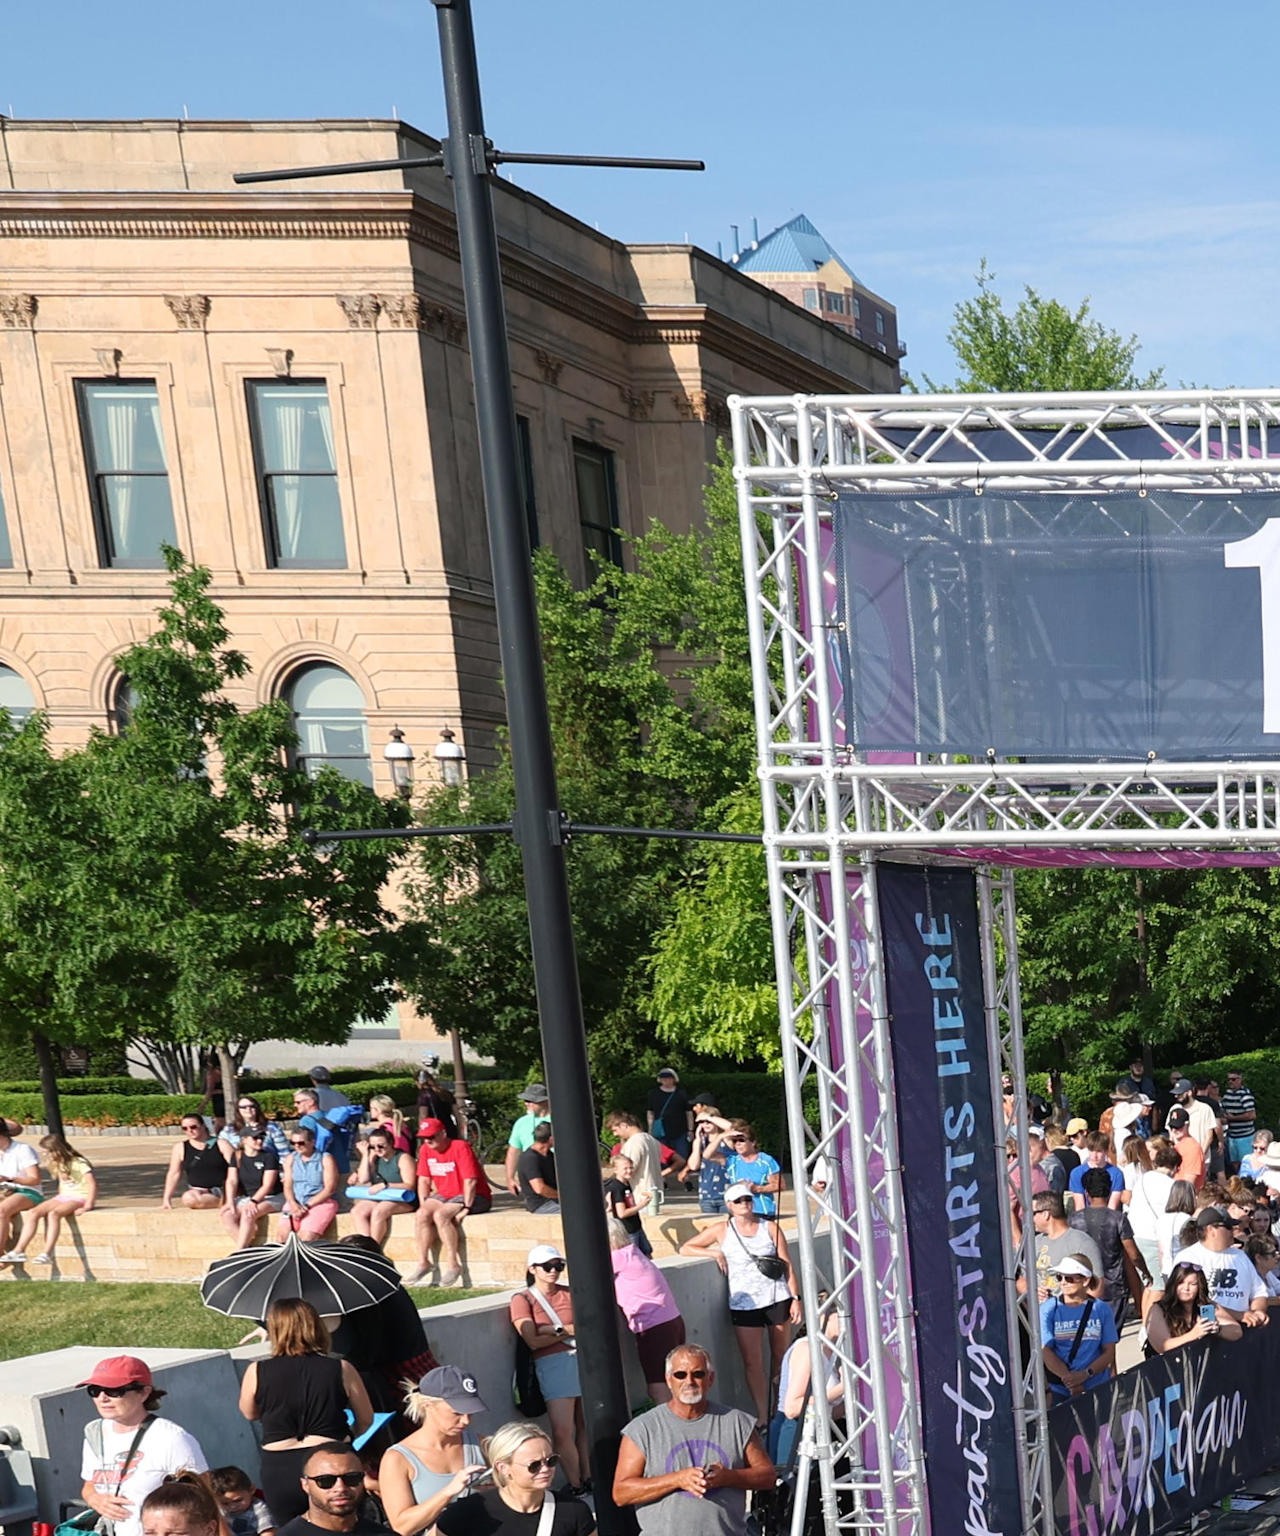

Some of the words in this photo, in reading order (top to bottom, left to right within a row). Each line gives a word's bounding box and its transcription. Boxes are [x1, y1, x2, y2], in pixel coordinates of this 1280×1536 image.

[914, 912, 972, 1078] HERE
[943, 1101, 988, 1337] STARTS
[1225, 1290, 1245, 1300] boys
